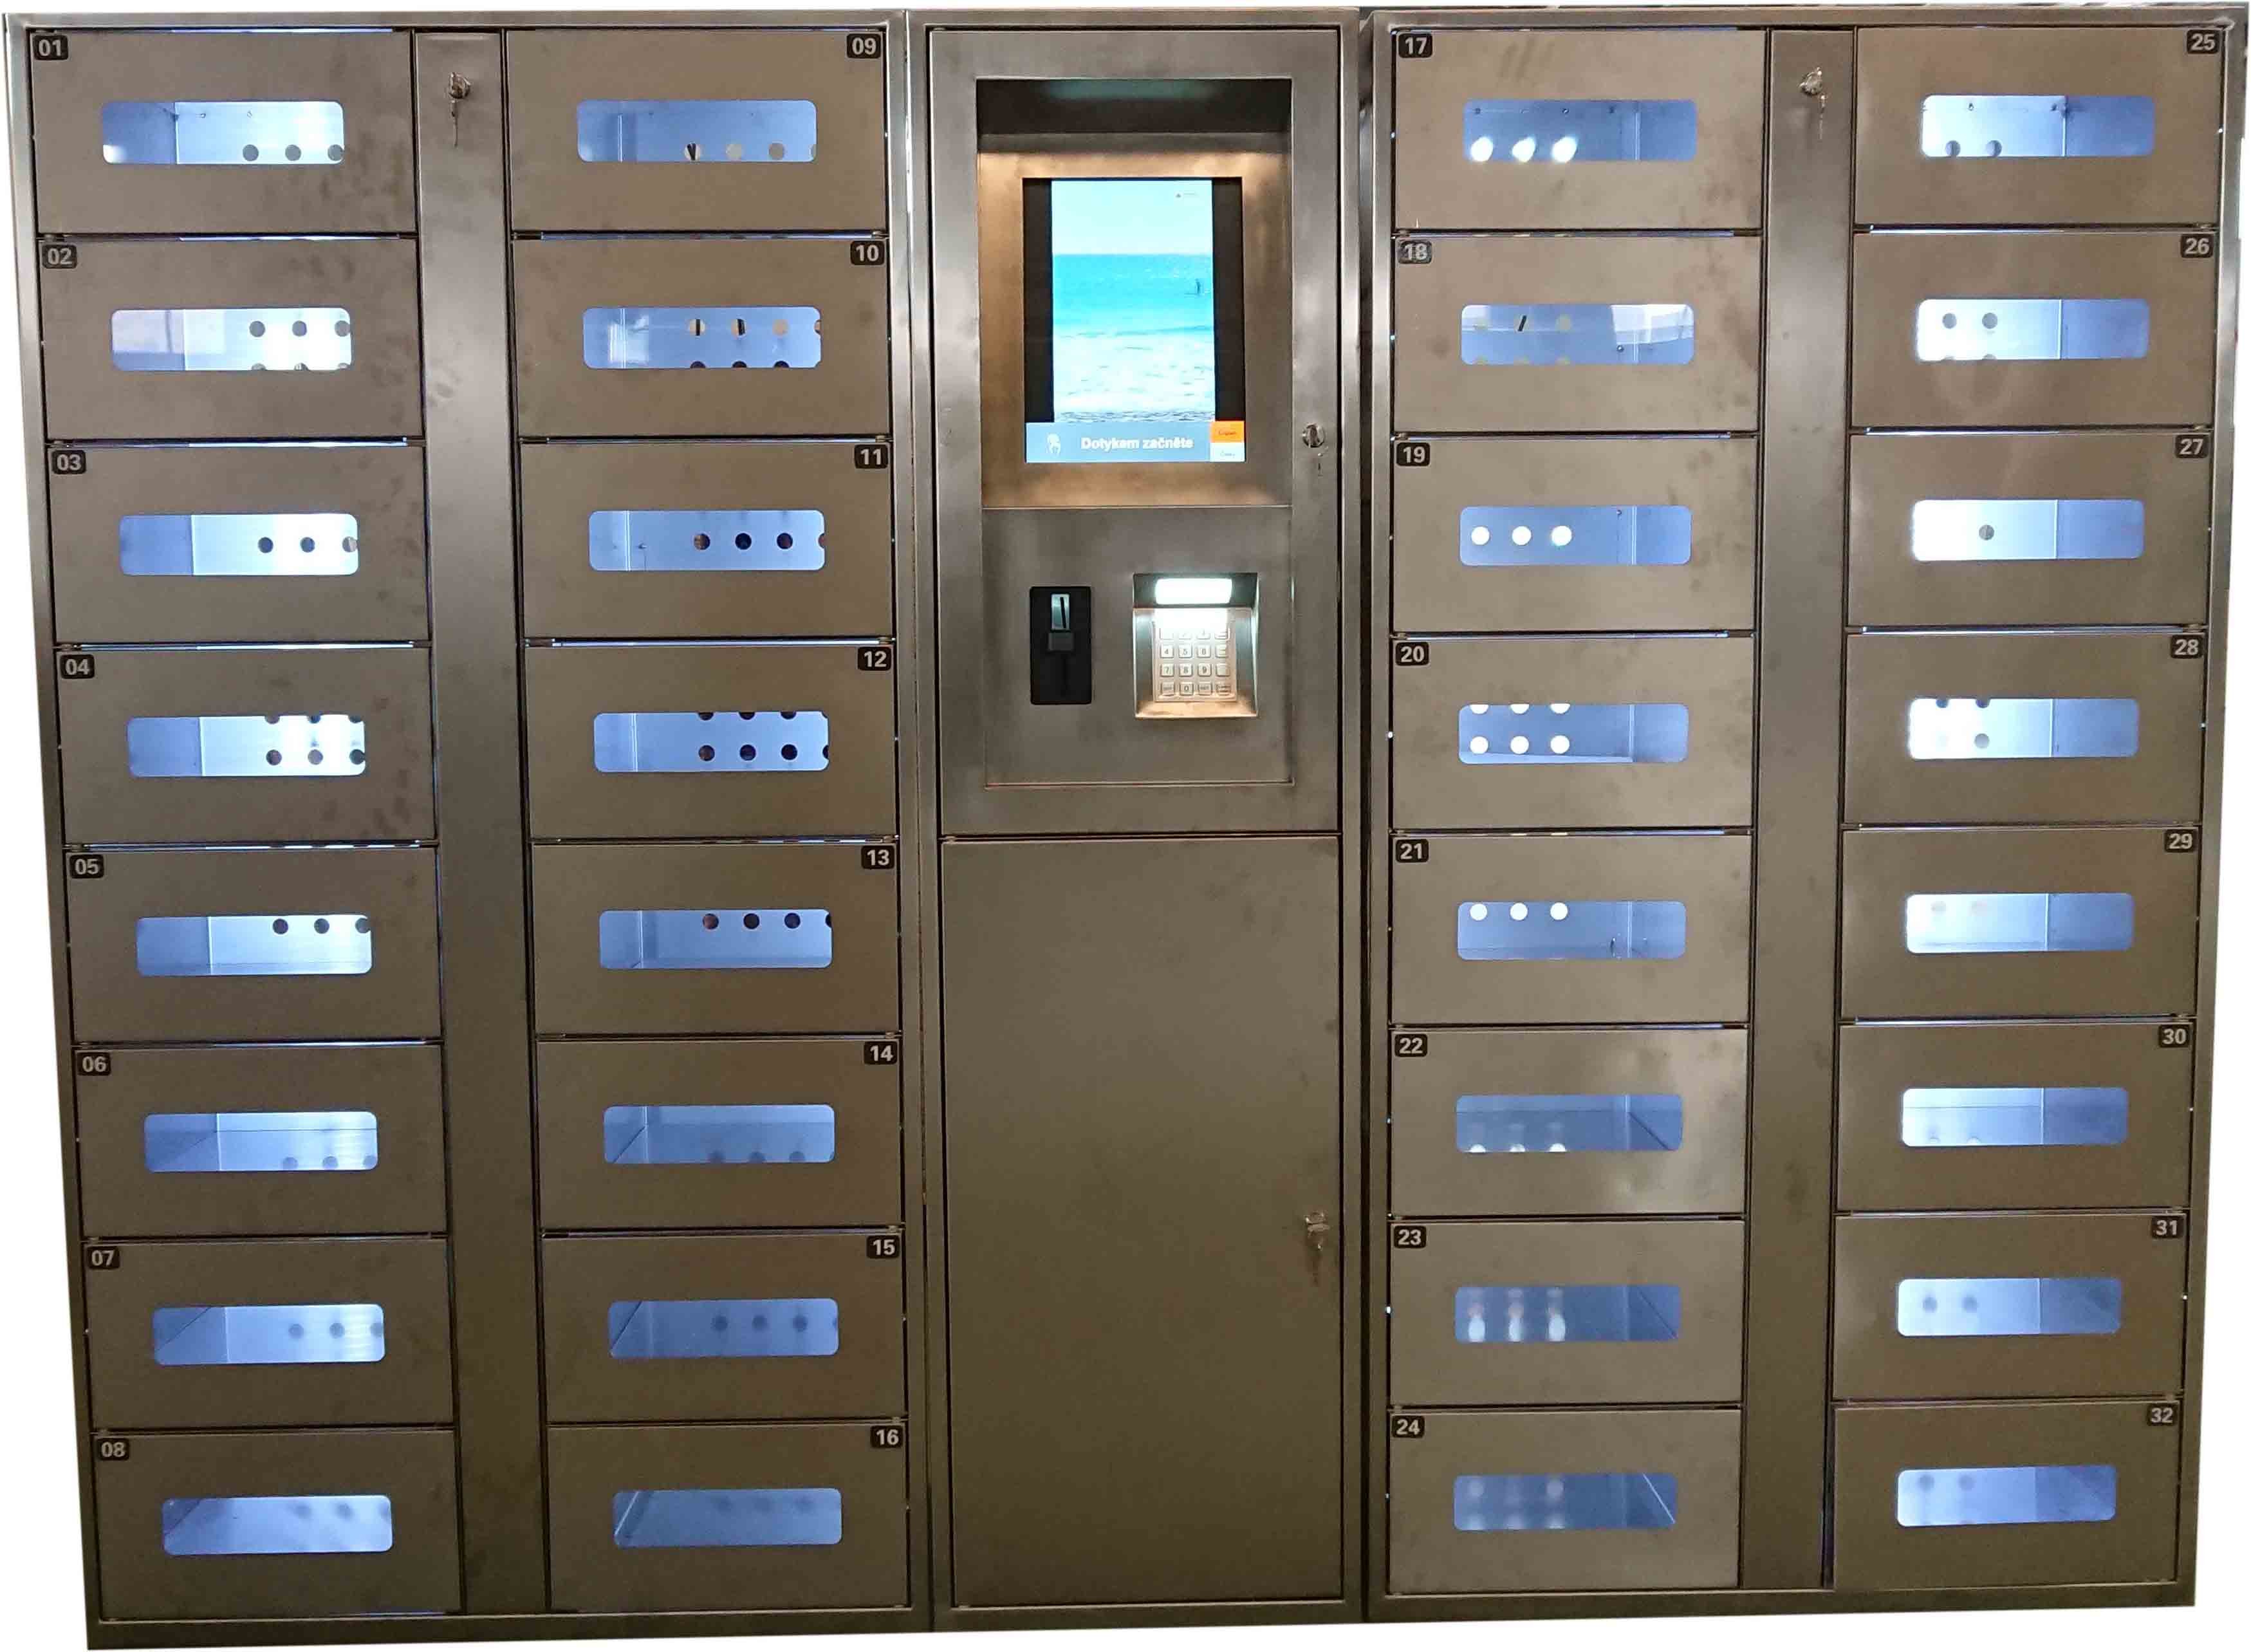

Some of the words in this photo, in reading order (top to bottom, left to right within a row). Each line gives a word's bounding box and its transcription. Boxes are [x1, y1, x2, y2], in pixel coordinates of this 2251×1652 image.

[39, 39, 61, 57] 01
[852, 37, 876, 55] 09
[1405, 37, 1427, 55] 17
[2191, 33, 2216, 51] 25
[856, 245, 879, 261] 10
[1403, 243, 1427, 261] 18
[2185, 237, 2210, 255] 26
[48, 248, 73, 265] 02
[1081, 437, 1139, 452] Dotykem
[2180, 438, 2204, 455] 27
[57, 454, 81, 471] 03
[860, 449, 881, 465] 11
[1403, 446, 1425, 463] 19
[1401, 645, 1425, 663] 20
[2174, 639, 2199, 655] 28
[66, 658, 90, 675] 04
[864, 651, 887, 667] 12
[2169, 833, 2192, 849] 29
[867, 849, 889, 866] 13
[1400, 843, 1422, 860] 21
[75, 858, 98, 875] 05
[2163, 1028, 2186, 1044] 30
[870, 1045, 893, 1061] 14
[1399, 1037, 1423, 1054] 22
[82, 1056, 106, 1072] 06
[2156, 1220, 2177, 1236] 31
[1398, 1229, 1422, 1245] 23
[873, 1239, 895, 1255] 15
[91, 1250, 114, 1266] 07
[2151, 1407, 2173, 1423] 32
[1396, 1419, 1420, 1435] 24
[876, 1429, 899, 1445] 16
[102, 1442, 125, 1457] 08
